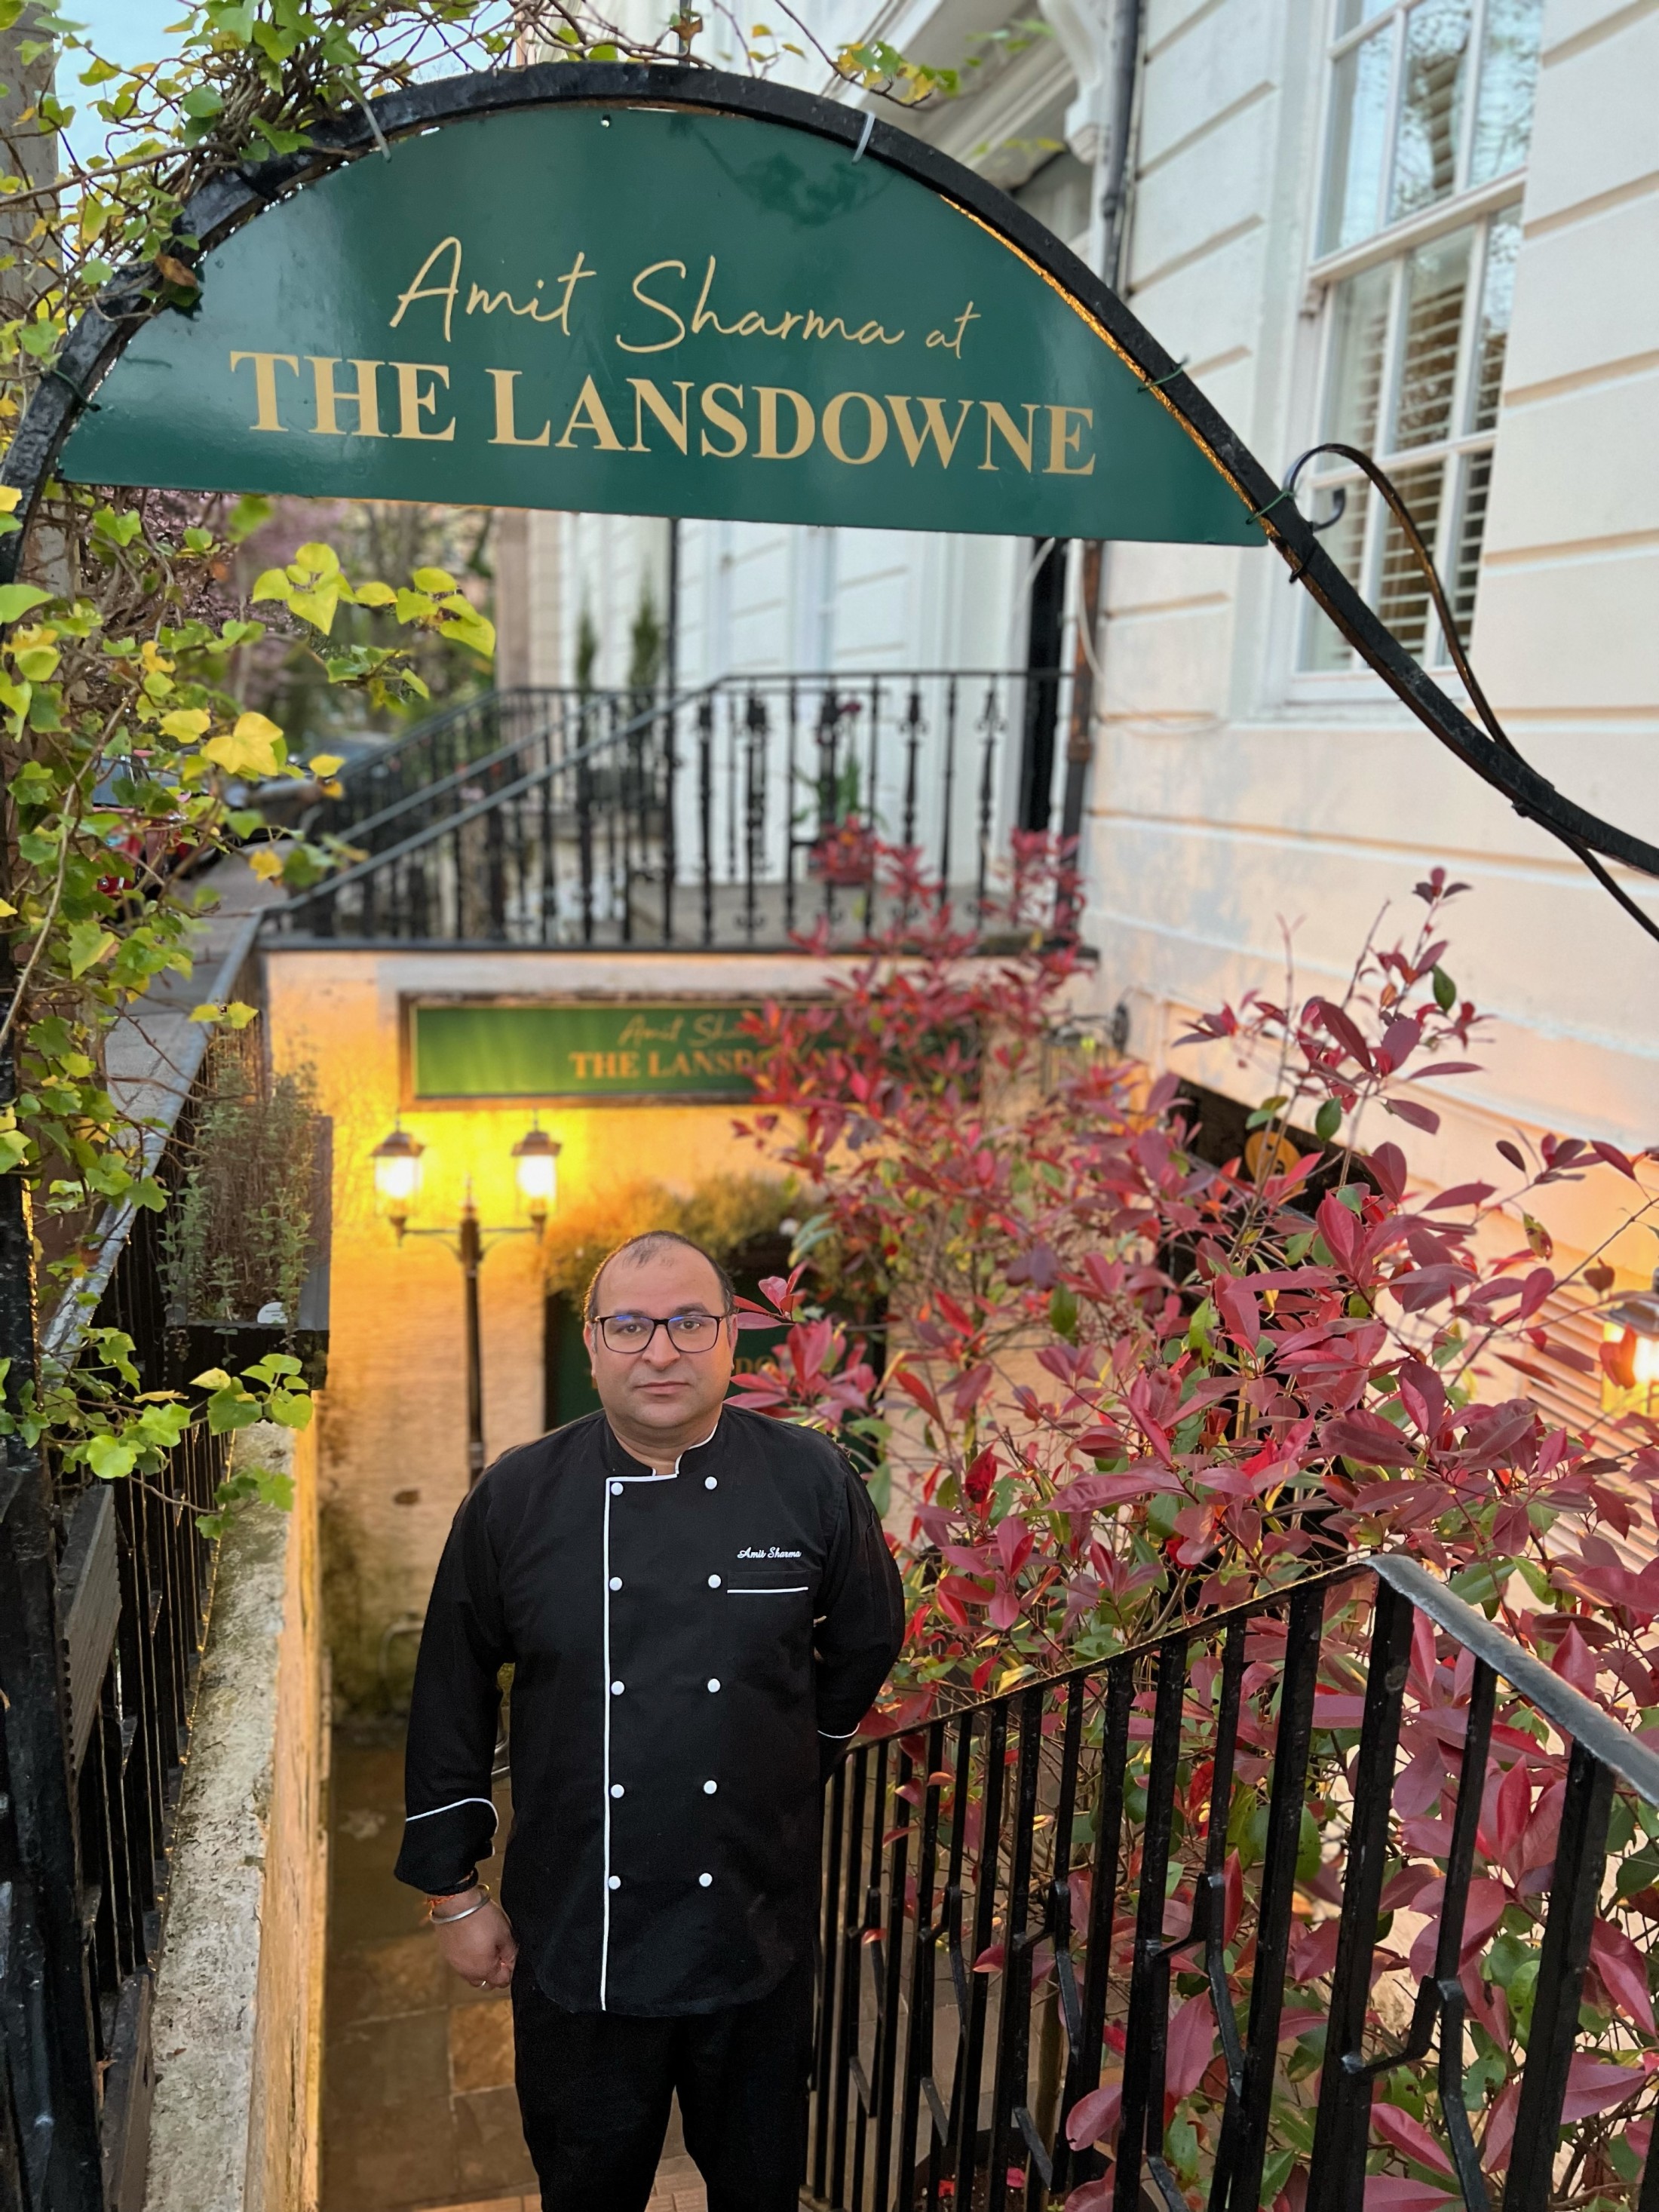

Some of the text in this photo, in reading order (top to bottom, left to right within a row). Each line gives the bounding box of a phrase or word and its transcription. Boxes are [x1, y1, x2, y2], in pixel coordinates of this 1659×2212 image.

[389, 236, 980, 359] Amit Sharma at
[230, 350, 1096, 475] THE LANSDOWNE
[569, 1050, 639, 1078] THE
[737, 1546, 802, 1559] Amit Sharma
